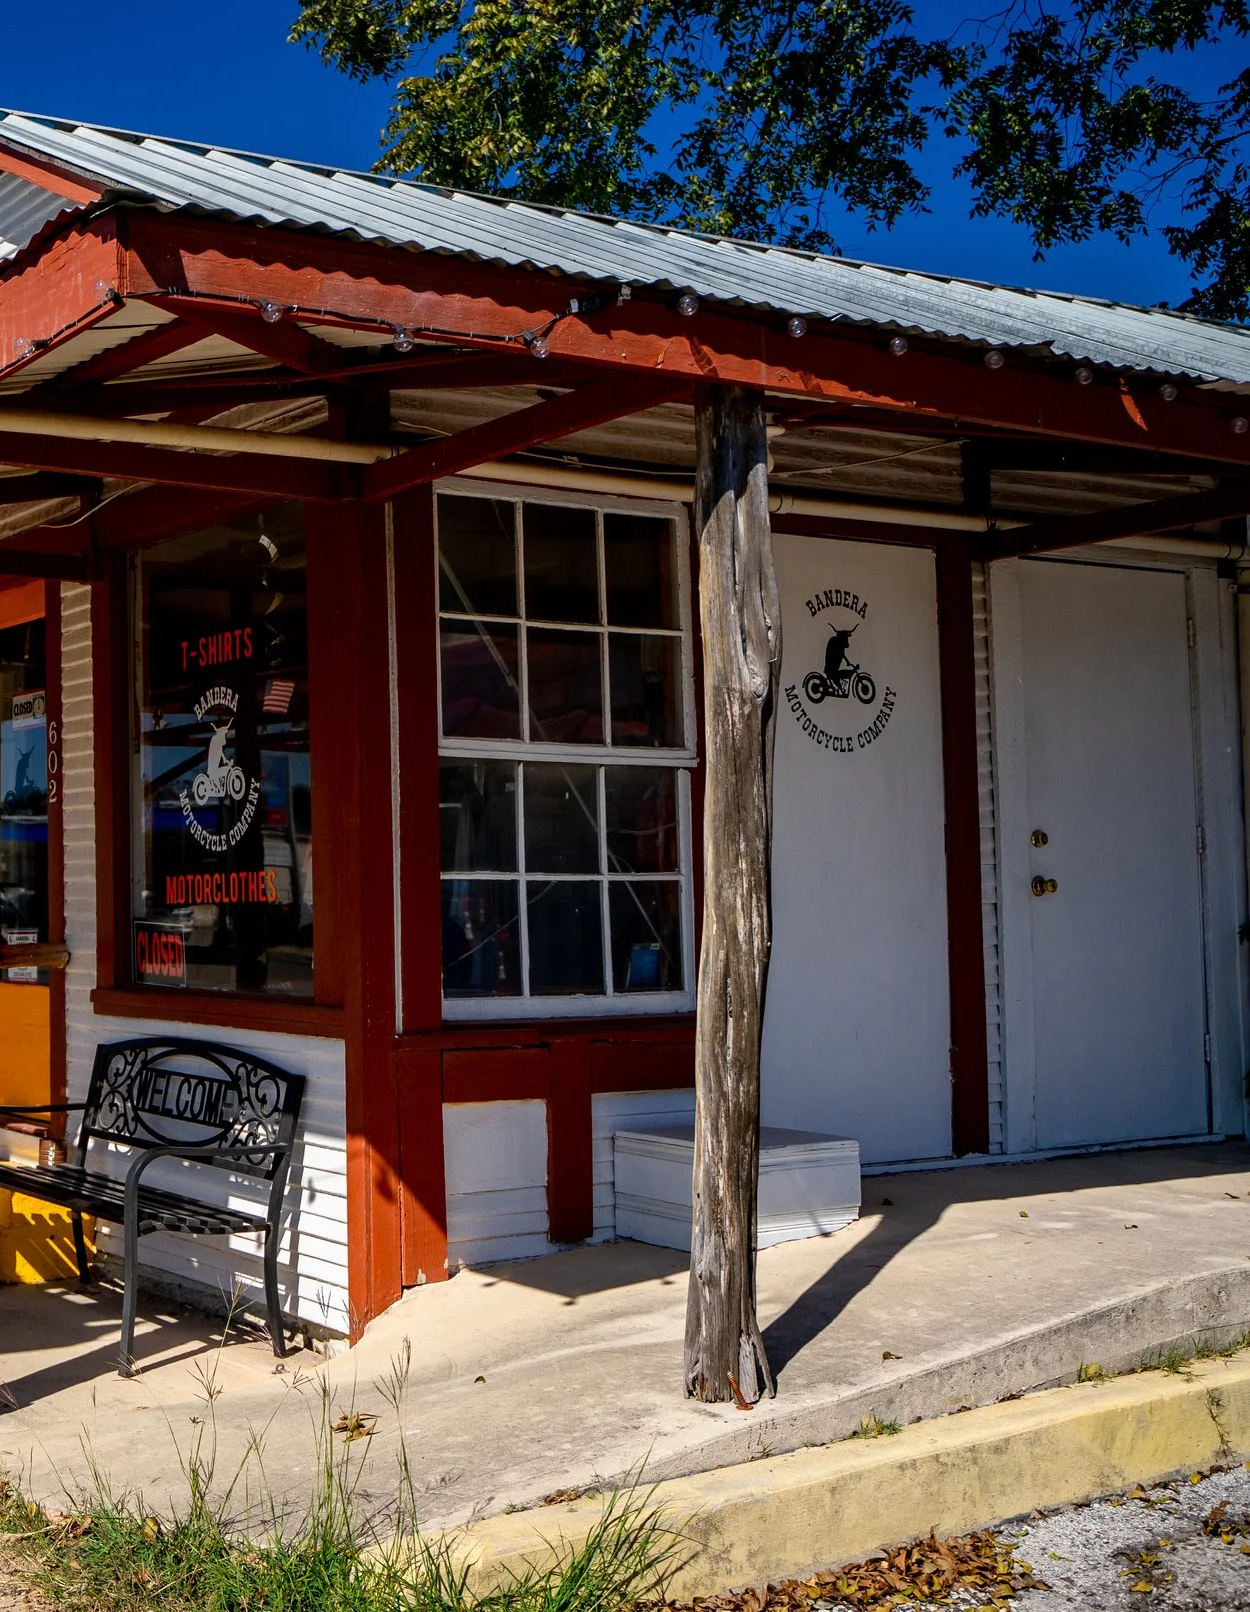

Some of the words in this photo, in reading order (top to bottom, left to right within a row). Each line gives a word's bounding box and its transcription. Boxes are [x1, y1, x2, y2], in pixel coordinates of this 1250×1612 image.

[805, 589, 868, 620] BANDERA
[181, 628, 254, 671] T-SHIRTS
[13, 701, 33, 716] CLOSED
[193, 686, 240, 721] BANDERA
[784, 684, 854, 753] MOTORCYCLE
[857, 686, 897, 749] COMPANY
[48, 721, 58, 803] 602
[179, 789, 228, 852] MOTORCYCLE
[229, 777, 261, 847] COMPANY
[166, 871, 278, 905] MOTORCLOTHES
[137, 931, 184, 977] CLOSED
[136, 1070, 238, 1127] WELCOME
